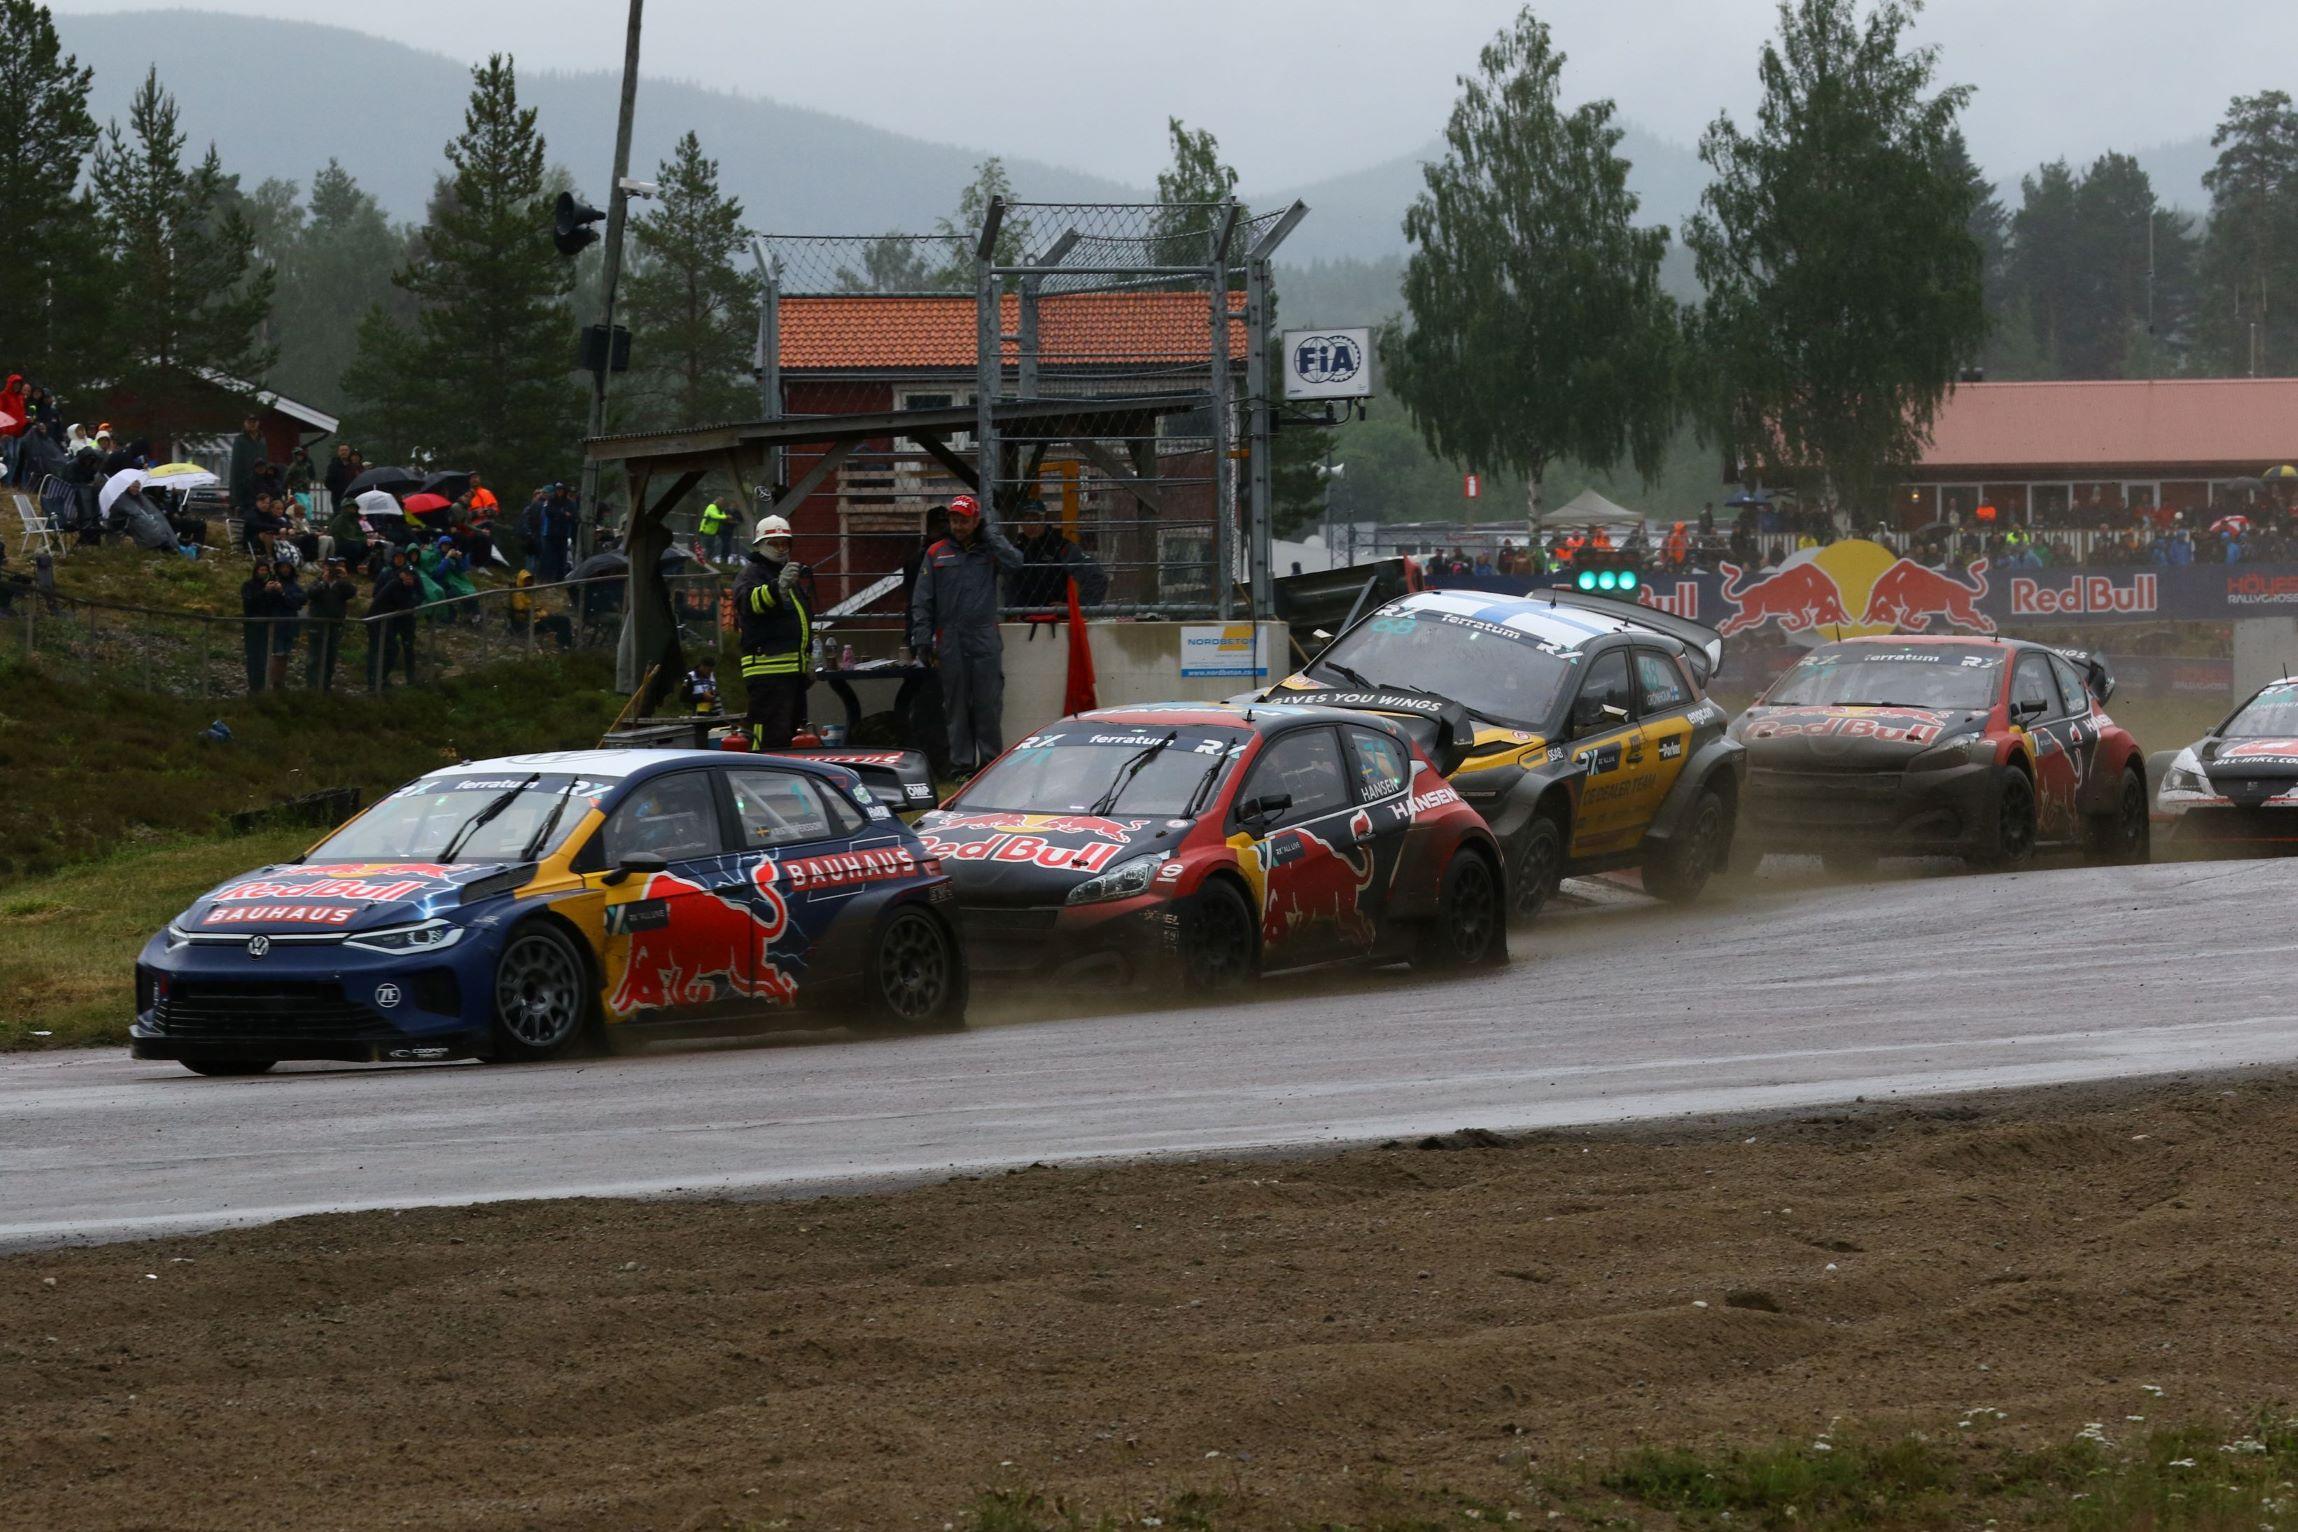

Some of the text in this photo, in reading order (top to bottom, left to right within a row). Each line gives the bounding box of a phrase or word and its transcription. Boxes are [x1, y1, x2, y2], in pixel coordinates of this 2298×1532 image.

[2011, 574, 2157, 614] Red Bull
[1440, 613, 1521, 640] ferratum
[1864, 653, 1940, 663] ferratum
[2053, 648, 2088, 659] NGS
[1334, 693, 1377, 705] YOU
[1377, 695, 1443, 712] WINGS
[1088, 734, 1175, 747] ferratum
[1744, 718, 1944, 747] Red Bull
[454, 779, 540, 790] ferratum
[905, 784, 931, 798] OMP
[1360, 778, 1400, 801] HANSEN
[1386, 787, 1461, 820] HANSEN
[990, 834, 1125, 874] Bull
[786, 846, 915, 886] BAUHAUS
[214, 879, 431, 902] Red Bull
[210, 907, 353, 923] BAUHAUS
